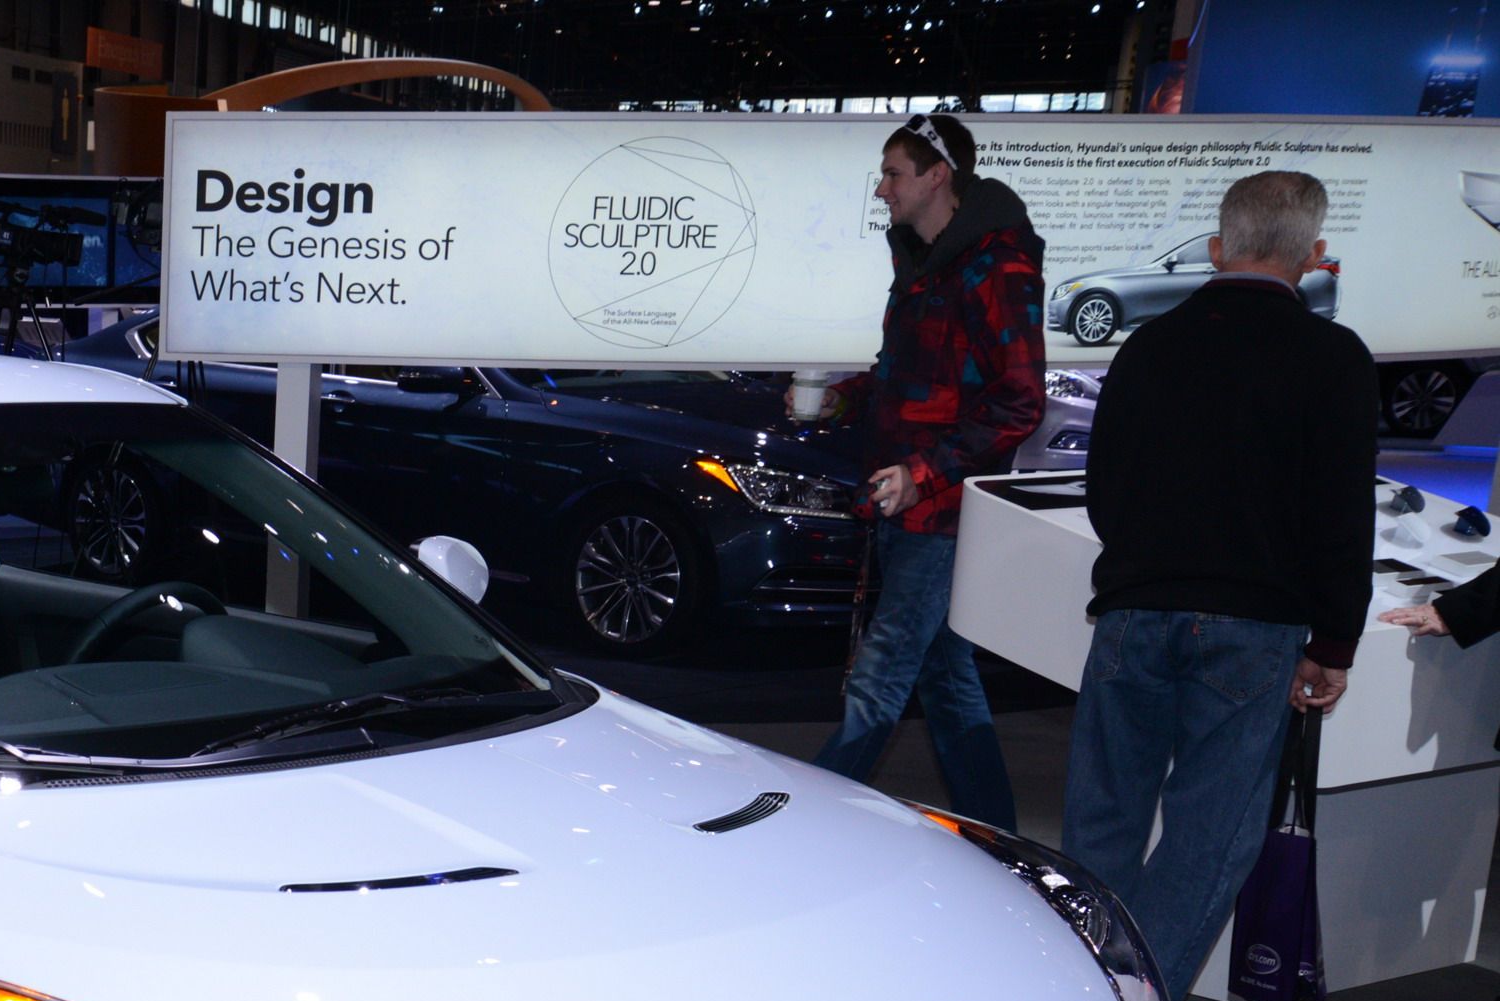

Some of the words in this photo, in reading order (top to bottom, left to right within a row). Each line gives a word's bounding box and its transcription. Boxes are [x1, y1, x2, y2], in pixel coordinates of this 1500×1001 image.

[990, 141, 1002, 151] its
[1006, 142, 1073, 153] introduction,
[1077, 143, 1126, 155] Hyundai's
[1130, 143, 1163, 154] unique
[1166, 142, 1198, 154] design
[1200, 142, 1251, 154] philosophy
[1254, 142, 1281, 152] Fluidic
[1284, 142, 1323, 153] Sculpture
[1326, 142, 1338, 152] has
[1341, 143, 1372, 153] evolved.
[978, 157, 1021, 167] All-New
[1024, 157, 1064, 167] Genesis
[1066, 157, 1074, 167] is
[1076, 157, 1093, 167] the
[1095, 157, 1115, 167] first
[1117, 157, 1165, 167] execution
[1167, 157, 1178, 167] of
[1179, 157, 1210, 167] Fluidic
[1212, 157, 1254, 167] Sculpture
[1256, 157, 1270, 166] 2.0
[1019, 177, 1042, 185] Fluidic
[1046, 177, 1079, 186] Sculpture
[196, 168, 374, 227] Design
[593, 196, 695, 221] FLUIDIC
[192, 224, 255, 257] The
[268, 226, 406, 260] Genesis
[419, 226, 457, 260] of
[564, 223, 718, 249] SCULPTURE
[620, 251, 656, 276] 2.0
[1462, 260, 1482, 278] THE
[190, 269, 304, 303] What's
[317, 272, 406, 305] Next.
[644, 310, 676, 318] Language
